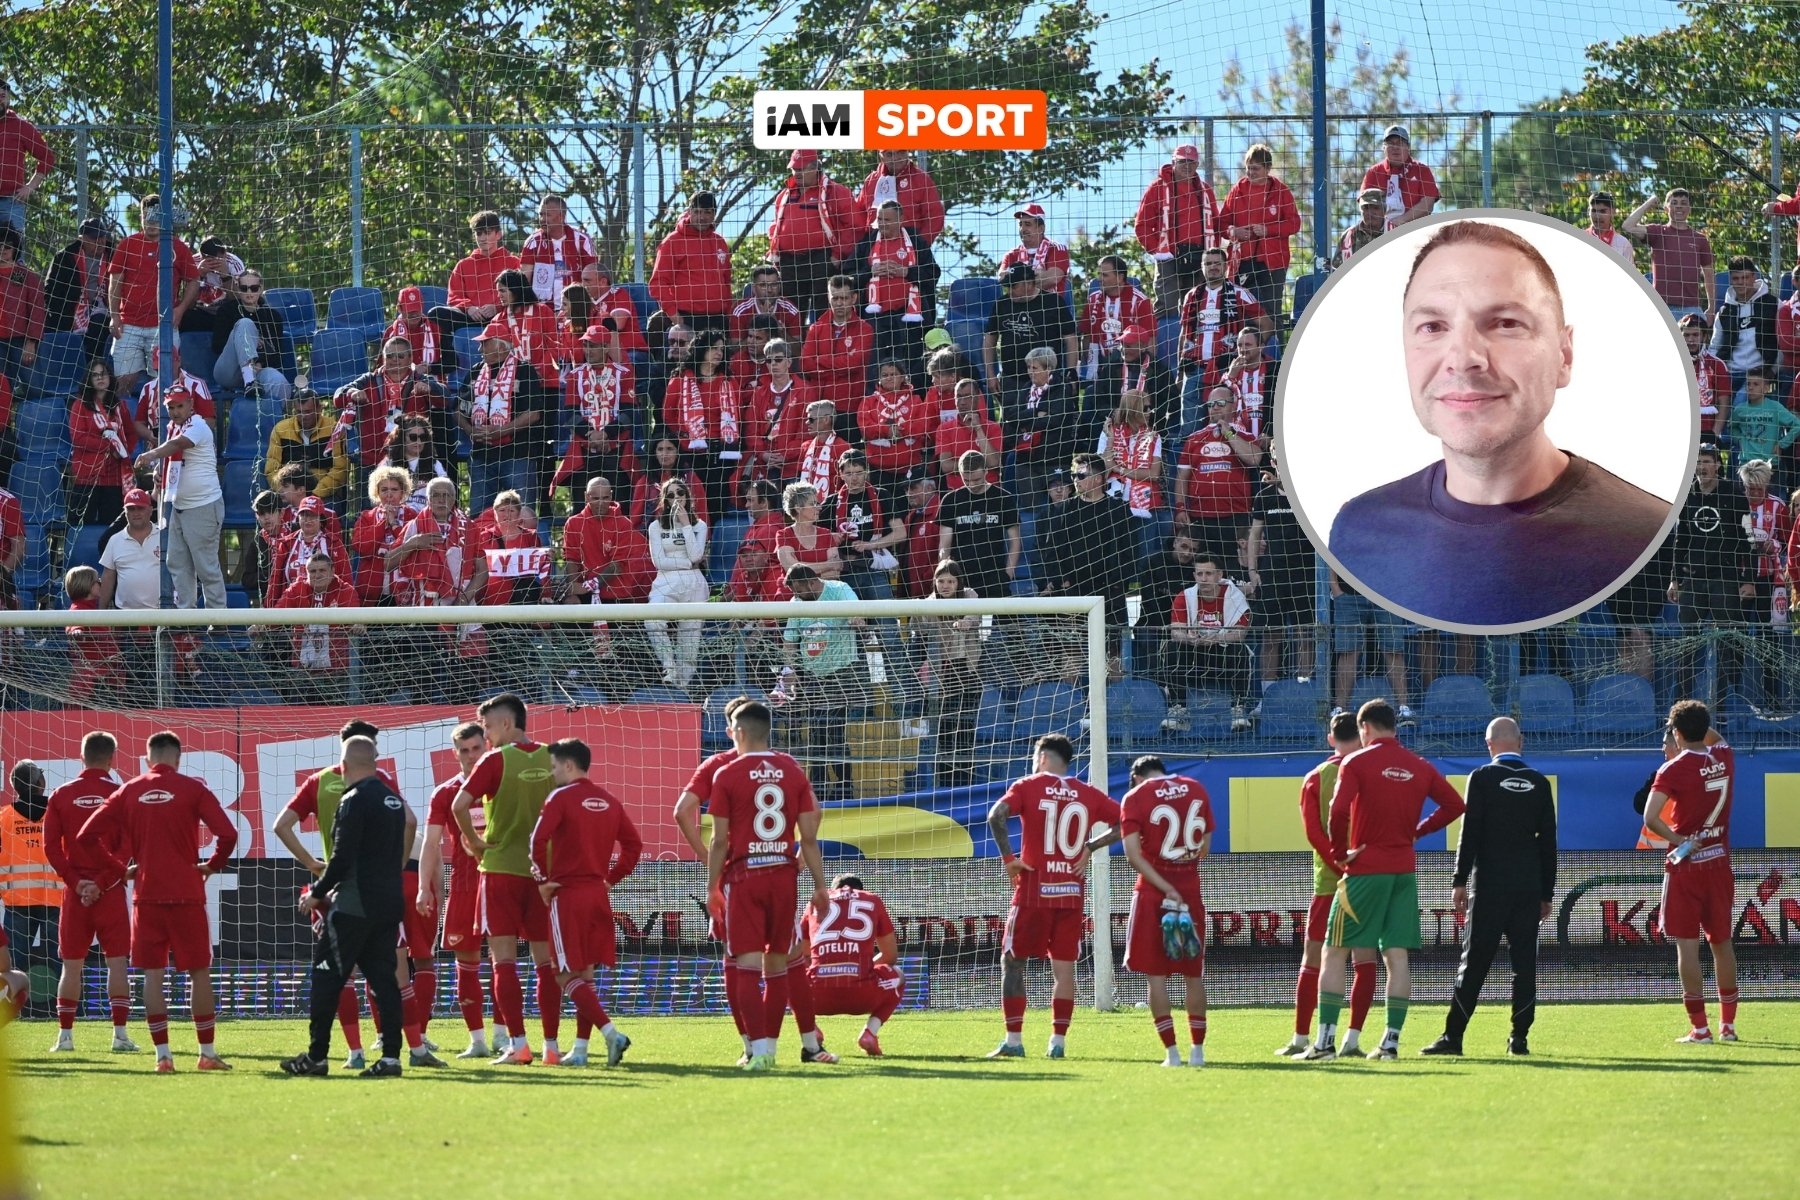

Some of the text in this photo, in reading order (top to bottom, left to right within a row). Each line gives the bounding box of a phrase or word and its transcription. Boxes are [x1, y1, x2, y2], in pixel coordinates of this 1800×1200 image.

[753, 783, 787, 842] 8
[1703, 776, 1729, 828] 7
[15, 826, 43, 835] STEWA
[748, 841, 788, 854] SKORUP
[1038, 799, 1089, 859] 10
[1149, 799, 1206, 860] 26
[1041, 885, 1080, 894] GYERMELYI
[815, 899, 875, 944] 25
[818, 966, 858, 974] GYERMELYI
